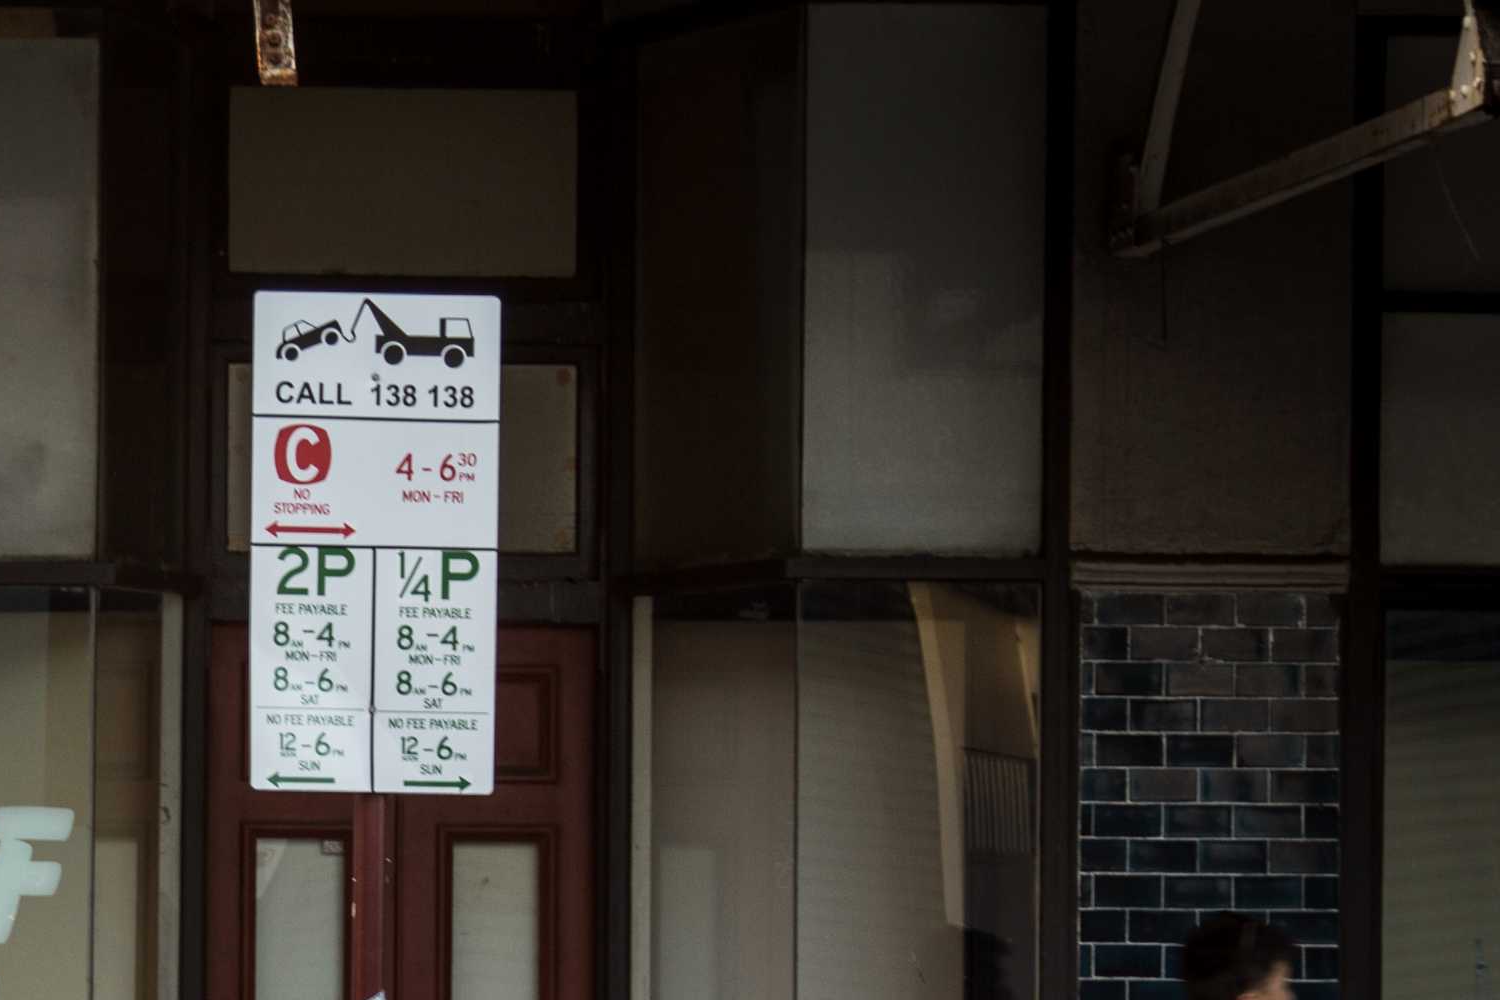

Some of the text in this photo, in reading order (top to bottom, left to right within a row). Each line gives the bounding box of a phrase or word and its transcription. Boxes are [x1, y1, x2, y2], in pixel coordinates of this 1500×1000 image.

[275, 380, 475, 408] CALL 138 138
[286, 425, 321, 483] C
[293, 488, 312, 500] NO
[273, 501, 331, 516] STOPPING
[276, 546, 356, 597] 2P
[275, 602, 349, 617] FEE PAYABLE
[398, 606, 473, 620] FEE PAYABLE
[299, 694, 320, 705] SAT
[422, 697, 443, 709] SAT
[266, 713, 356, 727] NO FEE PAYABLE
[387, 717, 479, 731] NO FEE PAYABLE
[298, 759, 322, 771] SUN
[419, 763, 443, 775] SUN
